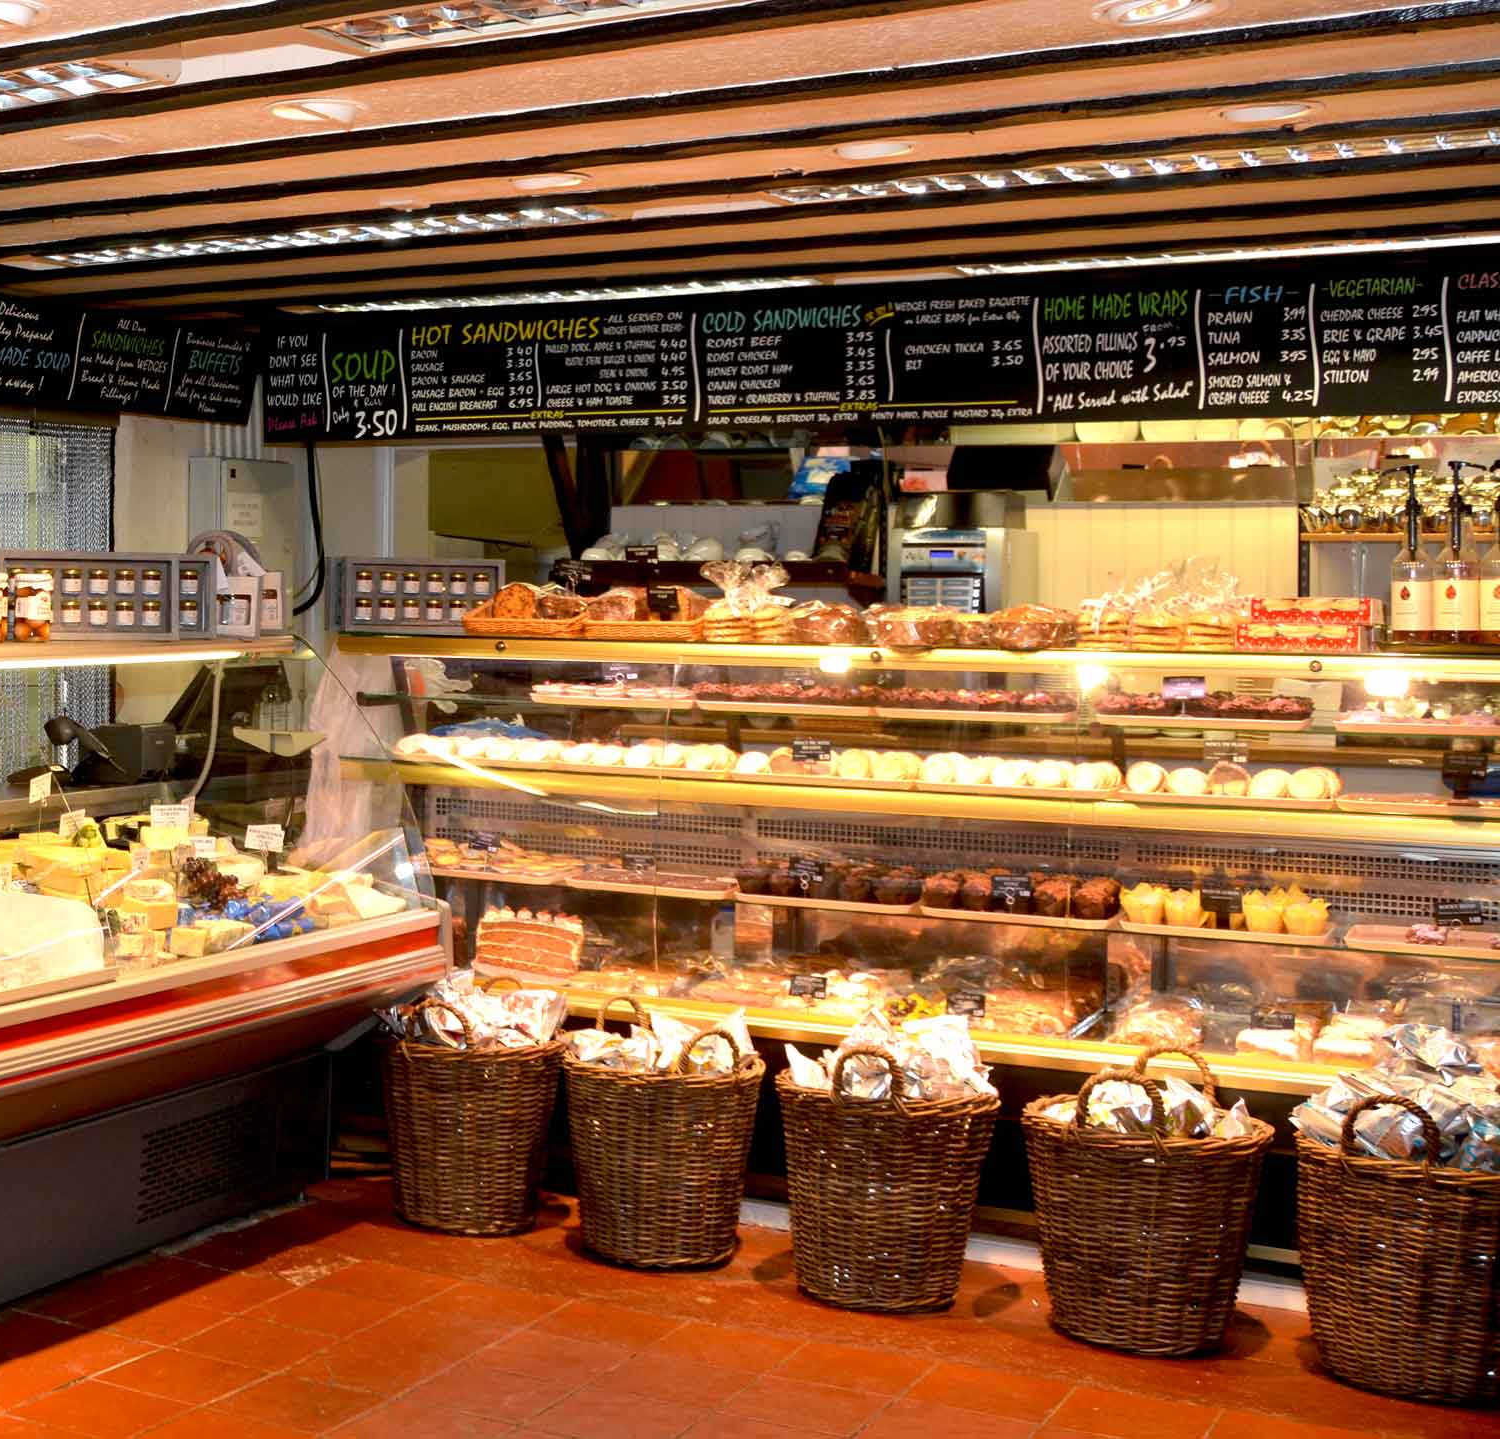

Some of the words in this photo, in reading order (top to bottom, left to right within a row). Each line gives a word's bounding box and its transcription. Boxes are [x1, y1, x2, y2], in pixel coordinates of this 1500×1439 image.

[1225, 285, 1283, 305] FISH
[1044, 295, 1086, 324] HOME
[1092, 292, 1132, 320] MADE
[1138, 289, 1189, 318] WRAPS
[1320, 308, 1364, 323] CHEDDAR
[1367, 306, 1404, 321] CHEESE
[667, 311, 684, 321] ON
[702, 311, 746, 334] COLD
[753, 304, 862, 333] SANDWICHES
[1207, 310, 1253, 326] PRAWN
[1456, 310, 1481, 325] FLAT
[15, 323, 55, 343] Prepared
[411, 325, 452, 348] HOT
[461, 316, 601, 346] SANDWICHES
[1207, 330, 1240, 345] TUNA
[1323, 328, 1350, 344] BRIE
[1366, 326, 1406, 343] GRAPE
[92, 330, 166, 358] SANDWICHES
[277, 334, 286, 350] IF
[289, 333, 308, 349] YOU
[706, 337, 745, 349] ROAST
[750, 335, 782, 348] BEEF
[904, 343, 951, 356] CHICKEN
[954, 341, 985, 354] TIKKA
[992, 339, 1022, 351] 3.65
[1042, 333, 1092, 355] ASSORTED
[1096, 331, 1138, 353] FILLINGS
[35, 350, 71, 373] SOUP
[187, 349, 243, 375] BUFFETS
[269, 353, 298, 369] DON'T
[301, 352, 318, 368] SEE
[706, 351, 735, 363] ROAST
[737, 349, 779, 362] CHICKEN
[992, 354, 1024, 367] 3.50
[1207, 351, 1260, 367] SALMON
[1322, 349, 1340, 366] EGG
[1353, 348, 1377, 364] MAYO
[1456, 350, 1491, 365] CAFFE
[332, 349, 396, 384] SOUP
[411, 361, 445, 373] SAUSAGE
[706, 366, 738, 377] HONEY
[740, 364, 769, 376] ROAST
[772, 364, 794, 373] HAM
[1045, 362, 1059, 382] OF
[1062, 361, 1091, 382] YOUR
[1094, 359, 1134, 381] CHOICE
[270, 374, 296, 388] WHAT
[299, 372, 318, 386] YOU
[451, 373, 487, 385] SAUSAGE
[740, 378, 781, 391] CHICKEN
[1207, 374, 1243, 390] SMOKED
[1246, 373, 1282, 389] SALMON
[1323, 369, 1369, 385] STILTON
[332, 385, 345, 398] OF
[348, 384, 366, 398] THE
[546, 383, 573, 395] LARGE
[575, 383, 591, 394] HOT
[1077, 389, 1116, 410] Served
[1120, 385, 1149, 405] with
[1207, 389, 1236, 406] CREAM
[1238, 389, 1270, 405] CHEESE
[1282, 389, 1314, 404] 4.25
[267, 393, 300, 407] WOULD
[303, 392, 323, 406] LIKE
[355, 408, 398, 439] 3.50
